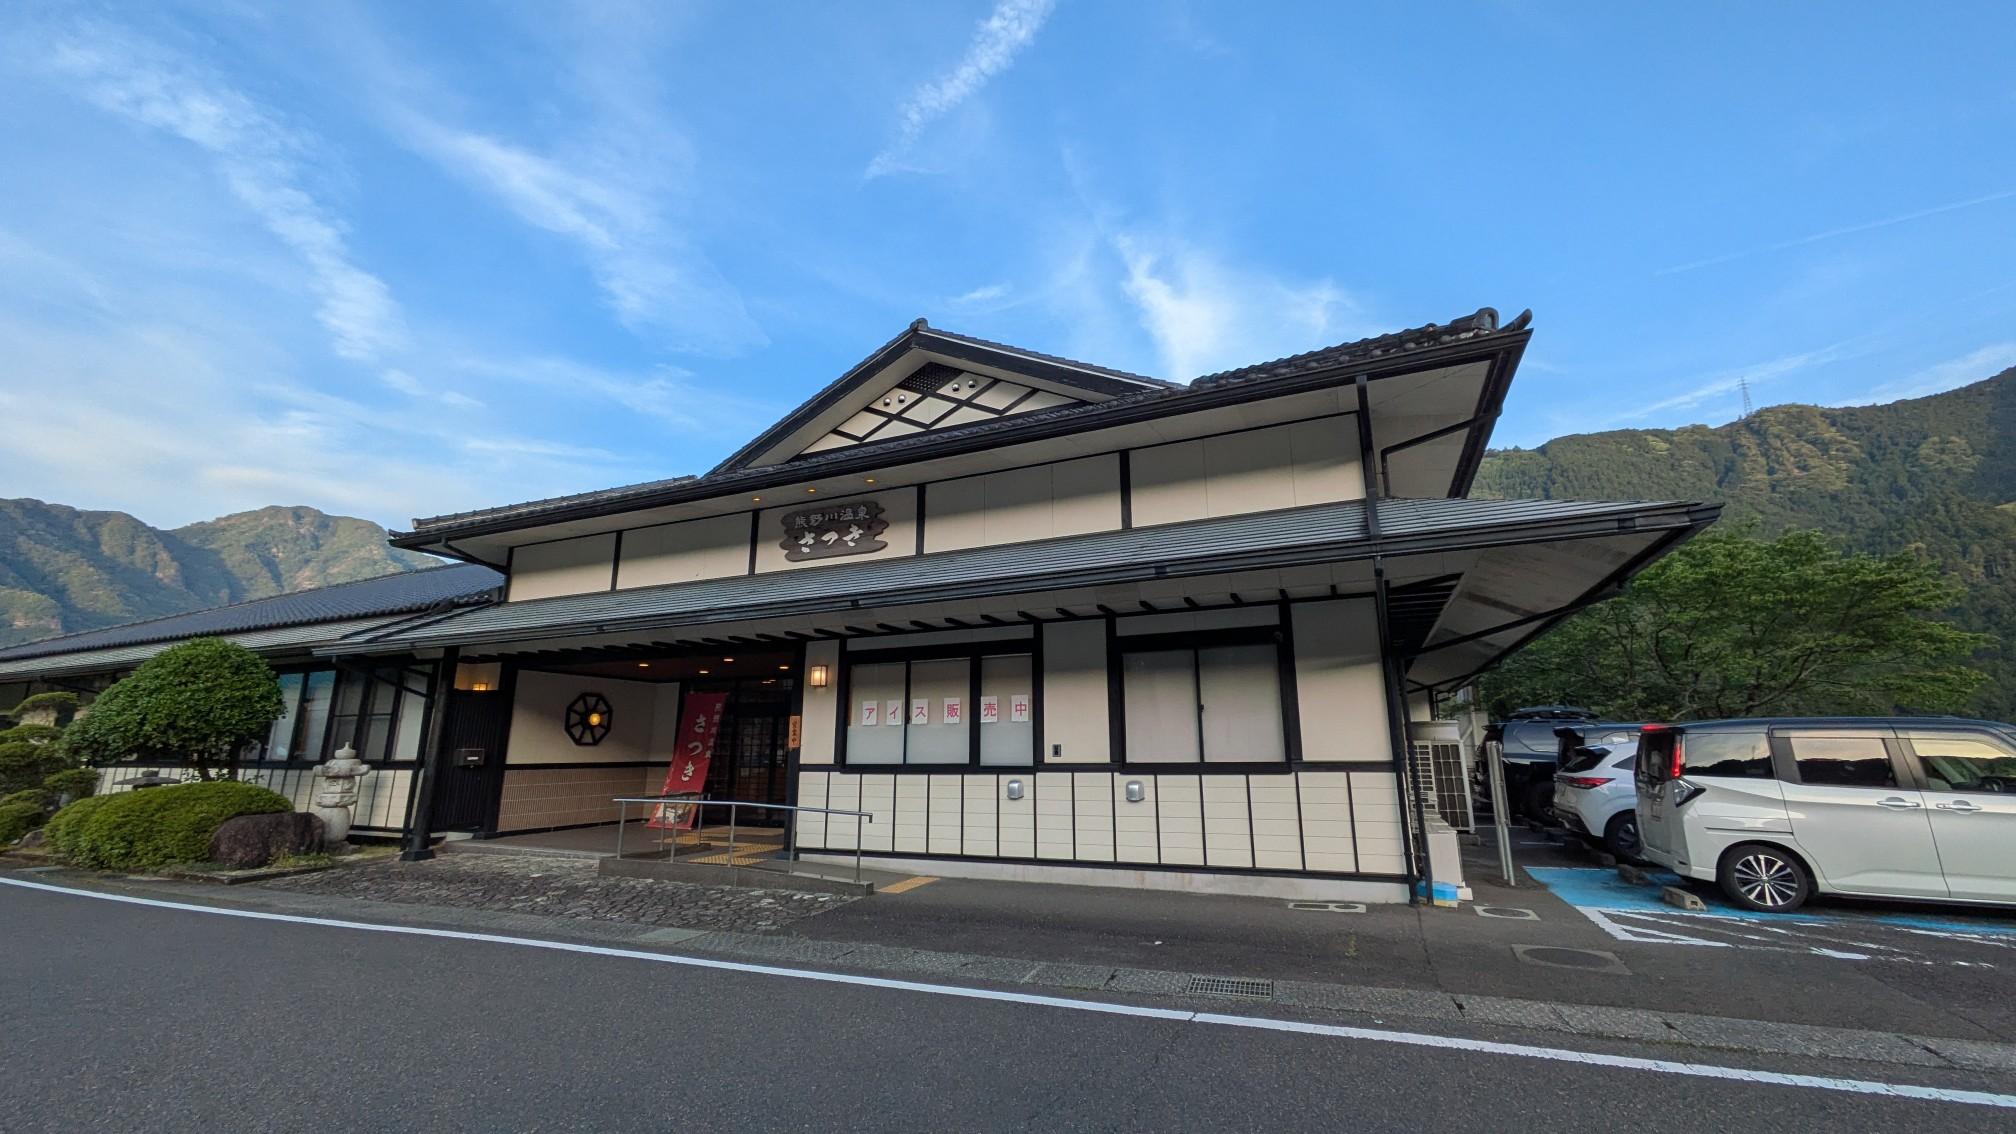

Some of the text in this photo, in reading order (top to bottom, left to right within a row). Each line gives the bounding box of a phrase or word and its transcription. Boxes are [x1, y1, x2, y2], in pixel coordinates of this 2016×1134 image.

[795, 505, 870, 528] 熊野川温泉
[798, 524, 864, 553] さつき
[864, 701, 1027, 720] アイス販売中
[681, 713, 707, 781] さつき
